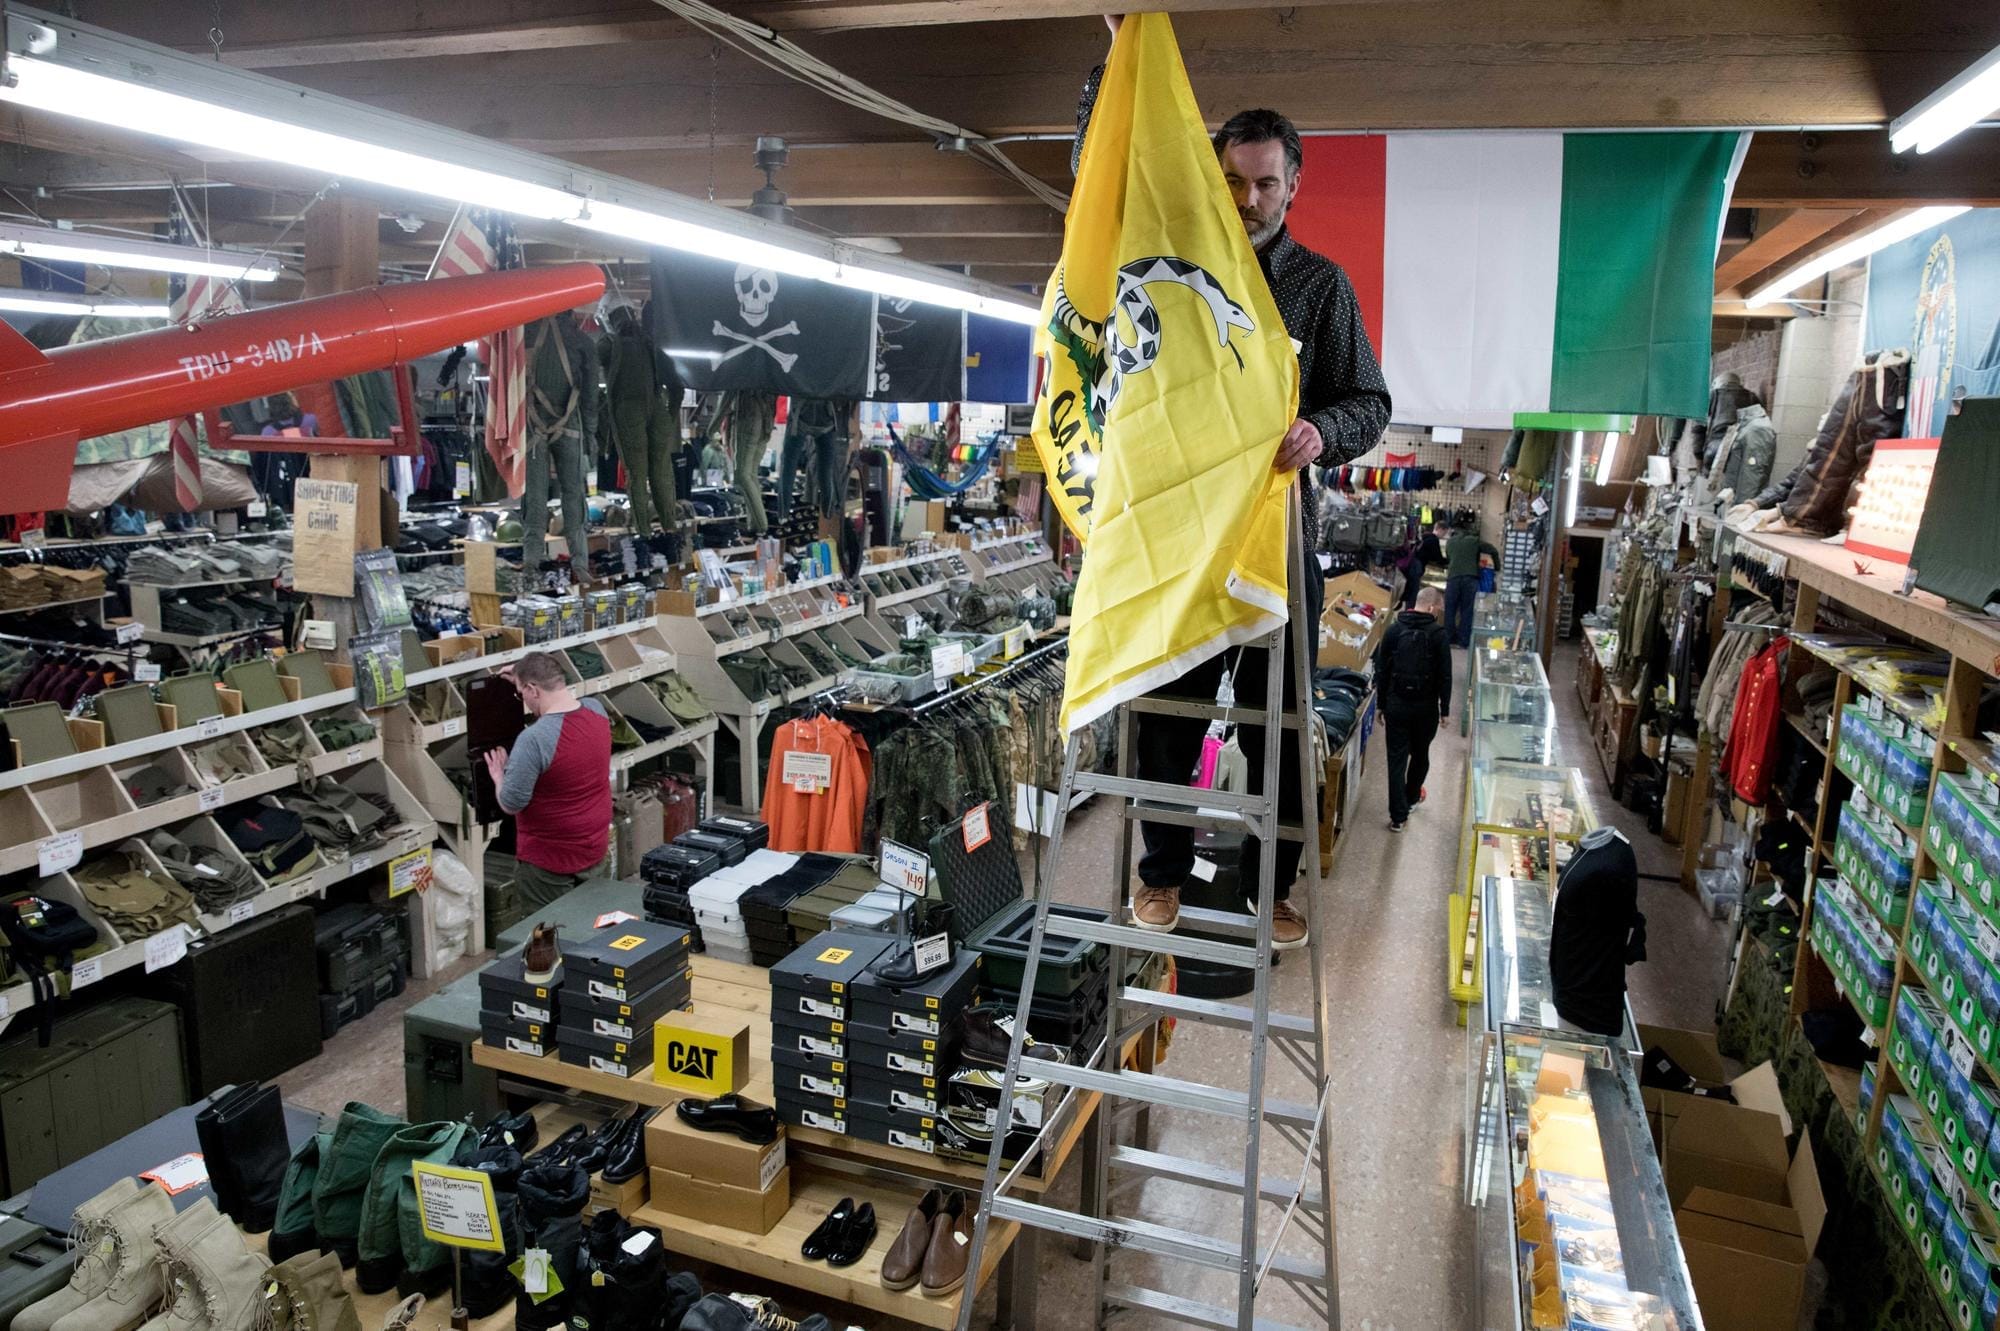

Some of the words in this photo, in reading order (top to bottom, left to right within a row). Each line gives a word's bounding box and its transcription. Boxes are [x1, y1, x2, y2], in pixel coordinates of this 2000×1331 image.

[297, 482, 355, 504] SHOPLIFTING
[308, 511, 339, 531] CRIME
[884, 850, 908, 867] ORSON
[904, 869, 924, 891] $149
[668, 1040, 718, 1081] CAT
[952, 1108, 978, 1119] Georgia
